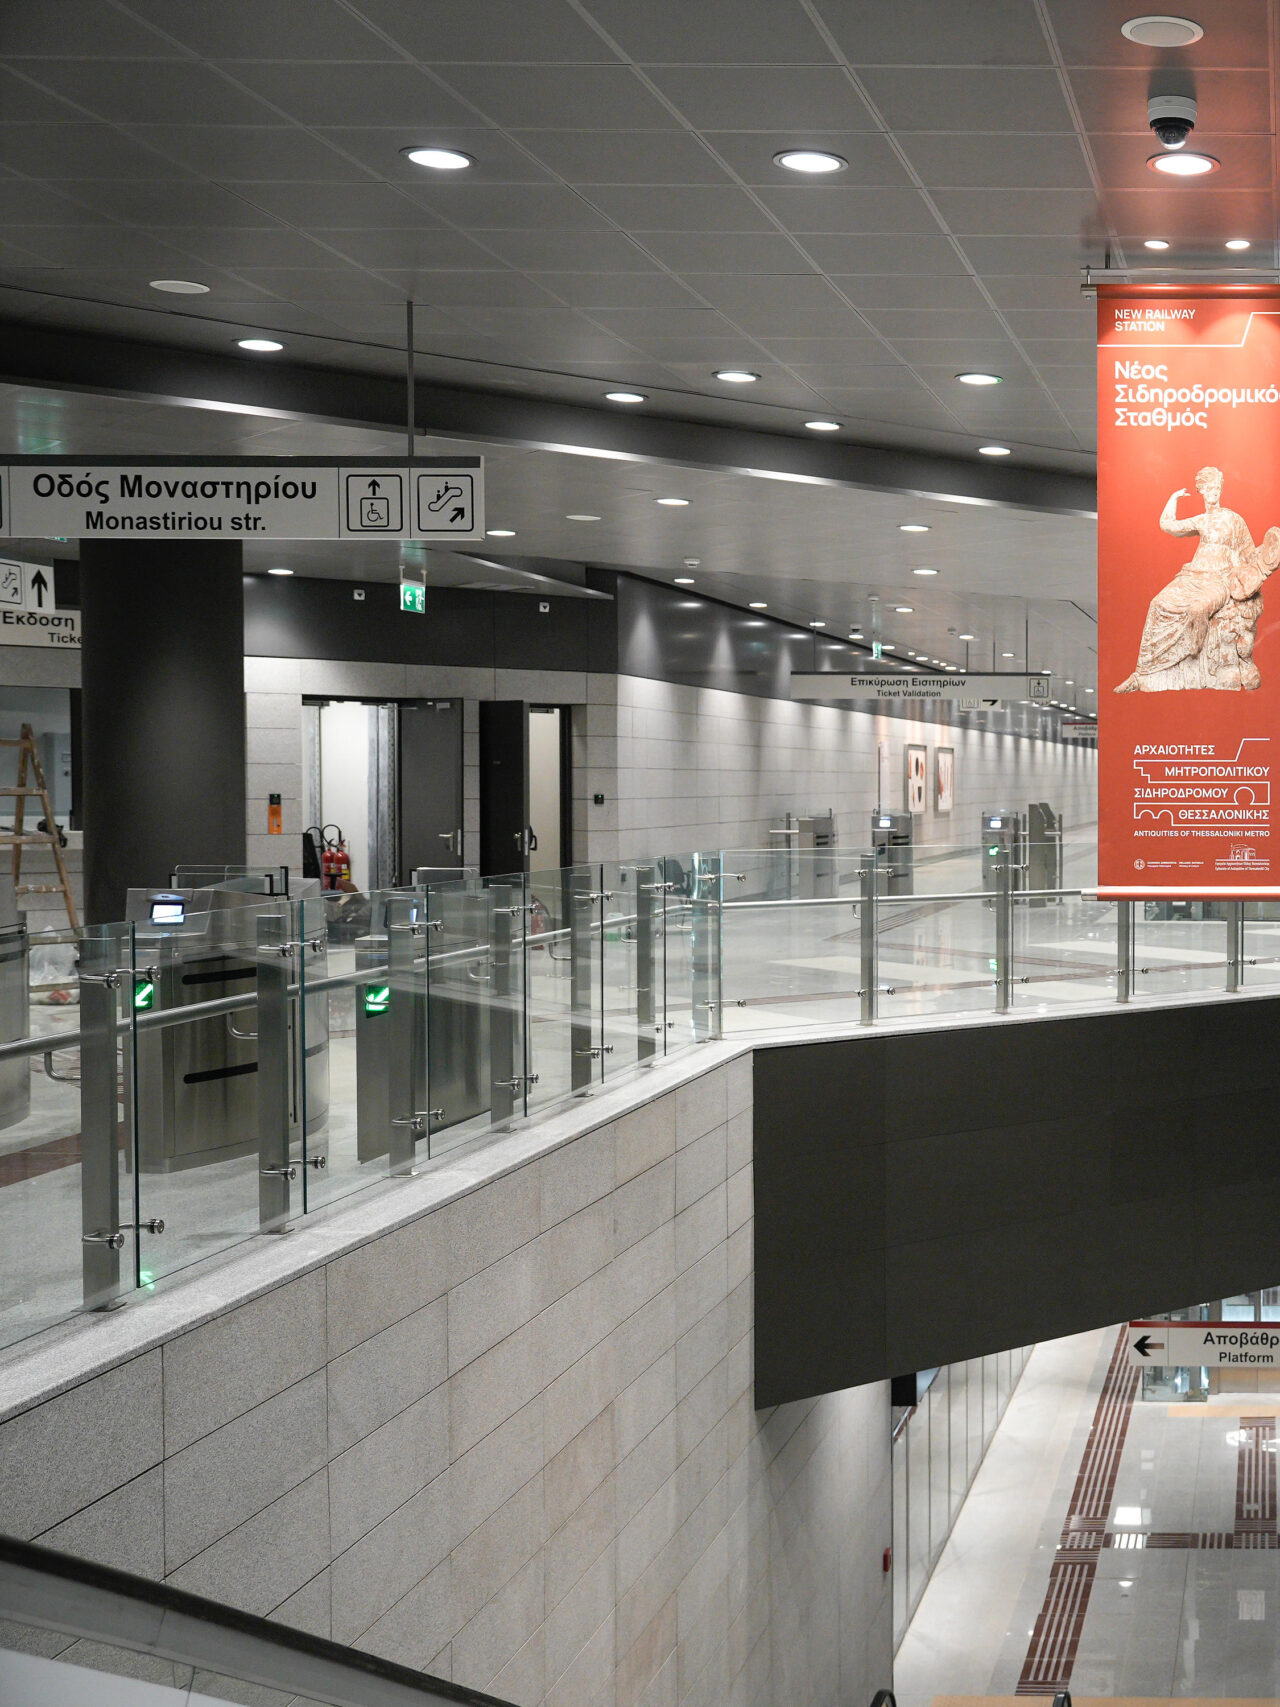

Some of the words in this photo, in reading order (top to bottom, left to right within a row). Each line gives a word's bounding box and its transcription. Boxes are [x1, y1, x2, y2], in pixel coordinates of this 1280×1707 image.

[1114, 309, 1142, 319] NEW
[1145, 309, 1196, 319] RAILWAY
[1114, 321, 1165, 332] STATION
[1114, 360, 1168, 382] Νέος
[1114, 407, 1208, 431] Σταθμός
[33, 472, 110, 504] Οδός
[119, 474, 317, 504] Μοναστηρίου
[85, 511, 222, 531] Monastiriou
[230, 513, 266, 531] str.
[850, 677, 908, 688] Επικύρωση
[911, 677, 966, 688] Εισιτηρίων
[1133, 745, 1215, 755] ΑΡΧΑΙΟΤΗΤΕΣ
[1164, 766, 1270, 777] ΜΗΤΡΟΠΟΛΙΤΙΚΟΥ
[1133, 788, 1228, 798] ΣΙΔΗΡΟΔΡΟΜΟΥ
[1178, 809, 1270, 820] ΘΕΣΣΑΛΟΝΙΚΗΣ
[1219, 1352, 1274, 1363] Platform
